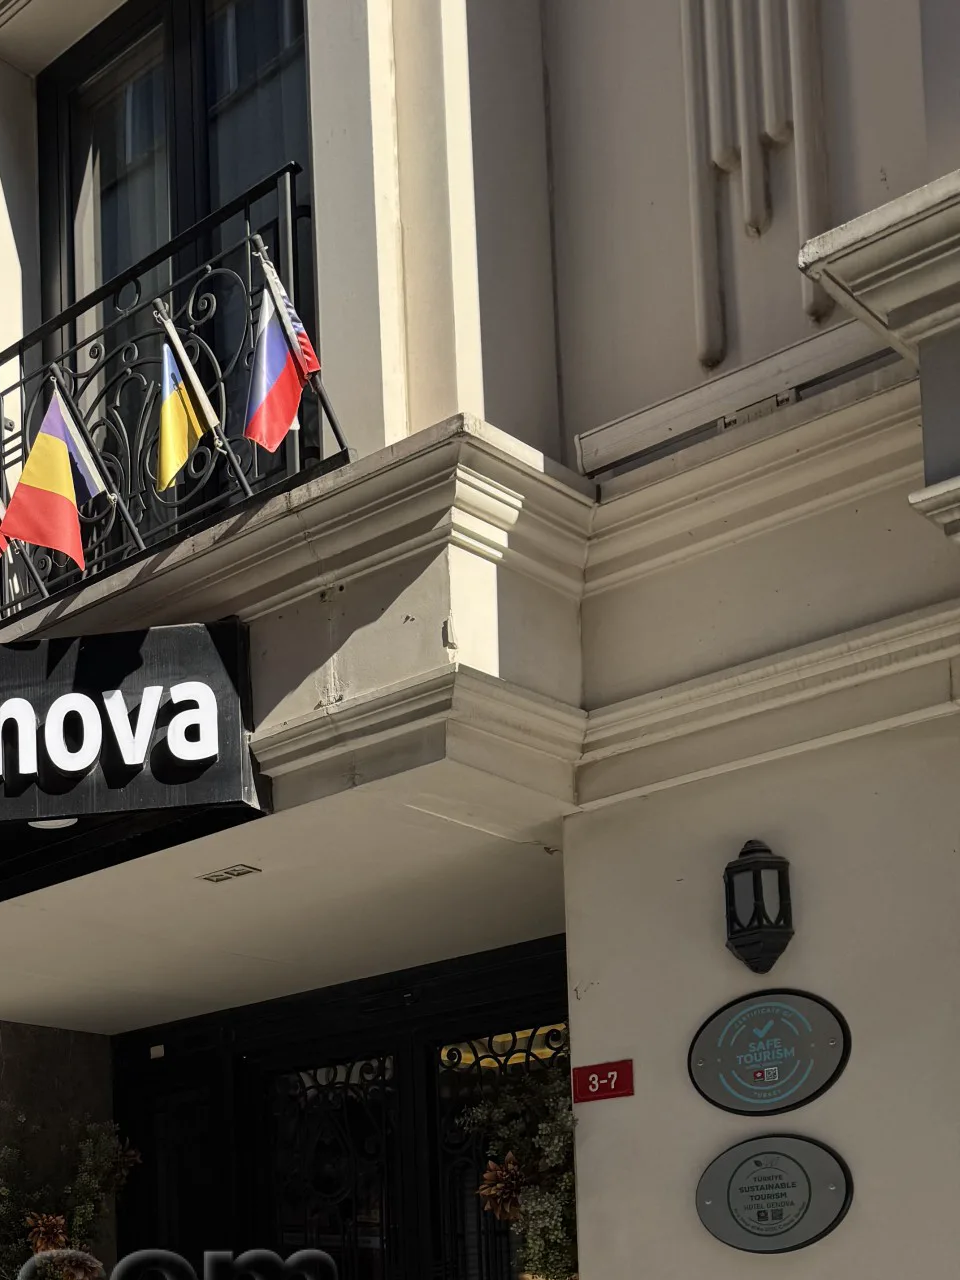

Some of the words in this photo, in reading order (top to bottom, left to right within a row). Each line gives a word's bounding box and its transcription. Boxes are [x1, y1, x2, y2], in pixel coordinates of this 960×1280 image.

[748, 1038, 782, 1053] SAFE
[736, 1046, 795, 1065] TOURISM
[588, 1070, 618, 1092] 3-7
[738, 1181, 797, 1194] SUSTAINABLE
[749, 1191, 788, 1202] TOURISM
[743, 1203, 765, 1211] HOTEL
